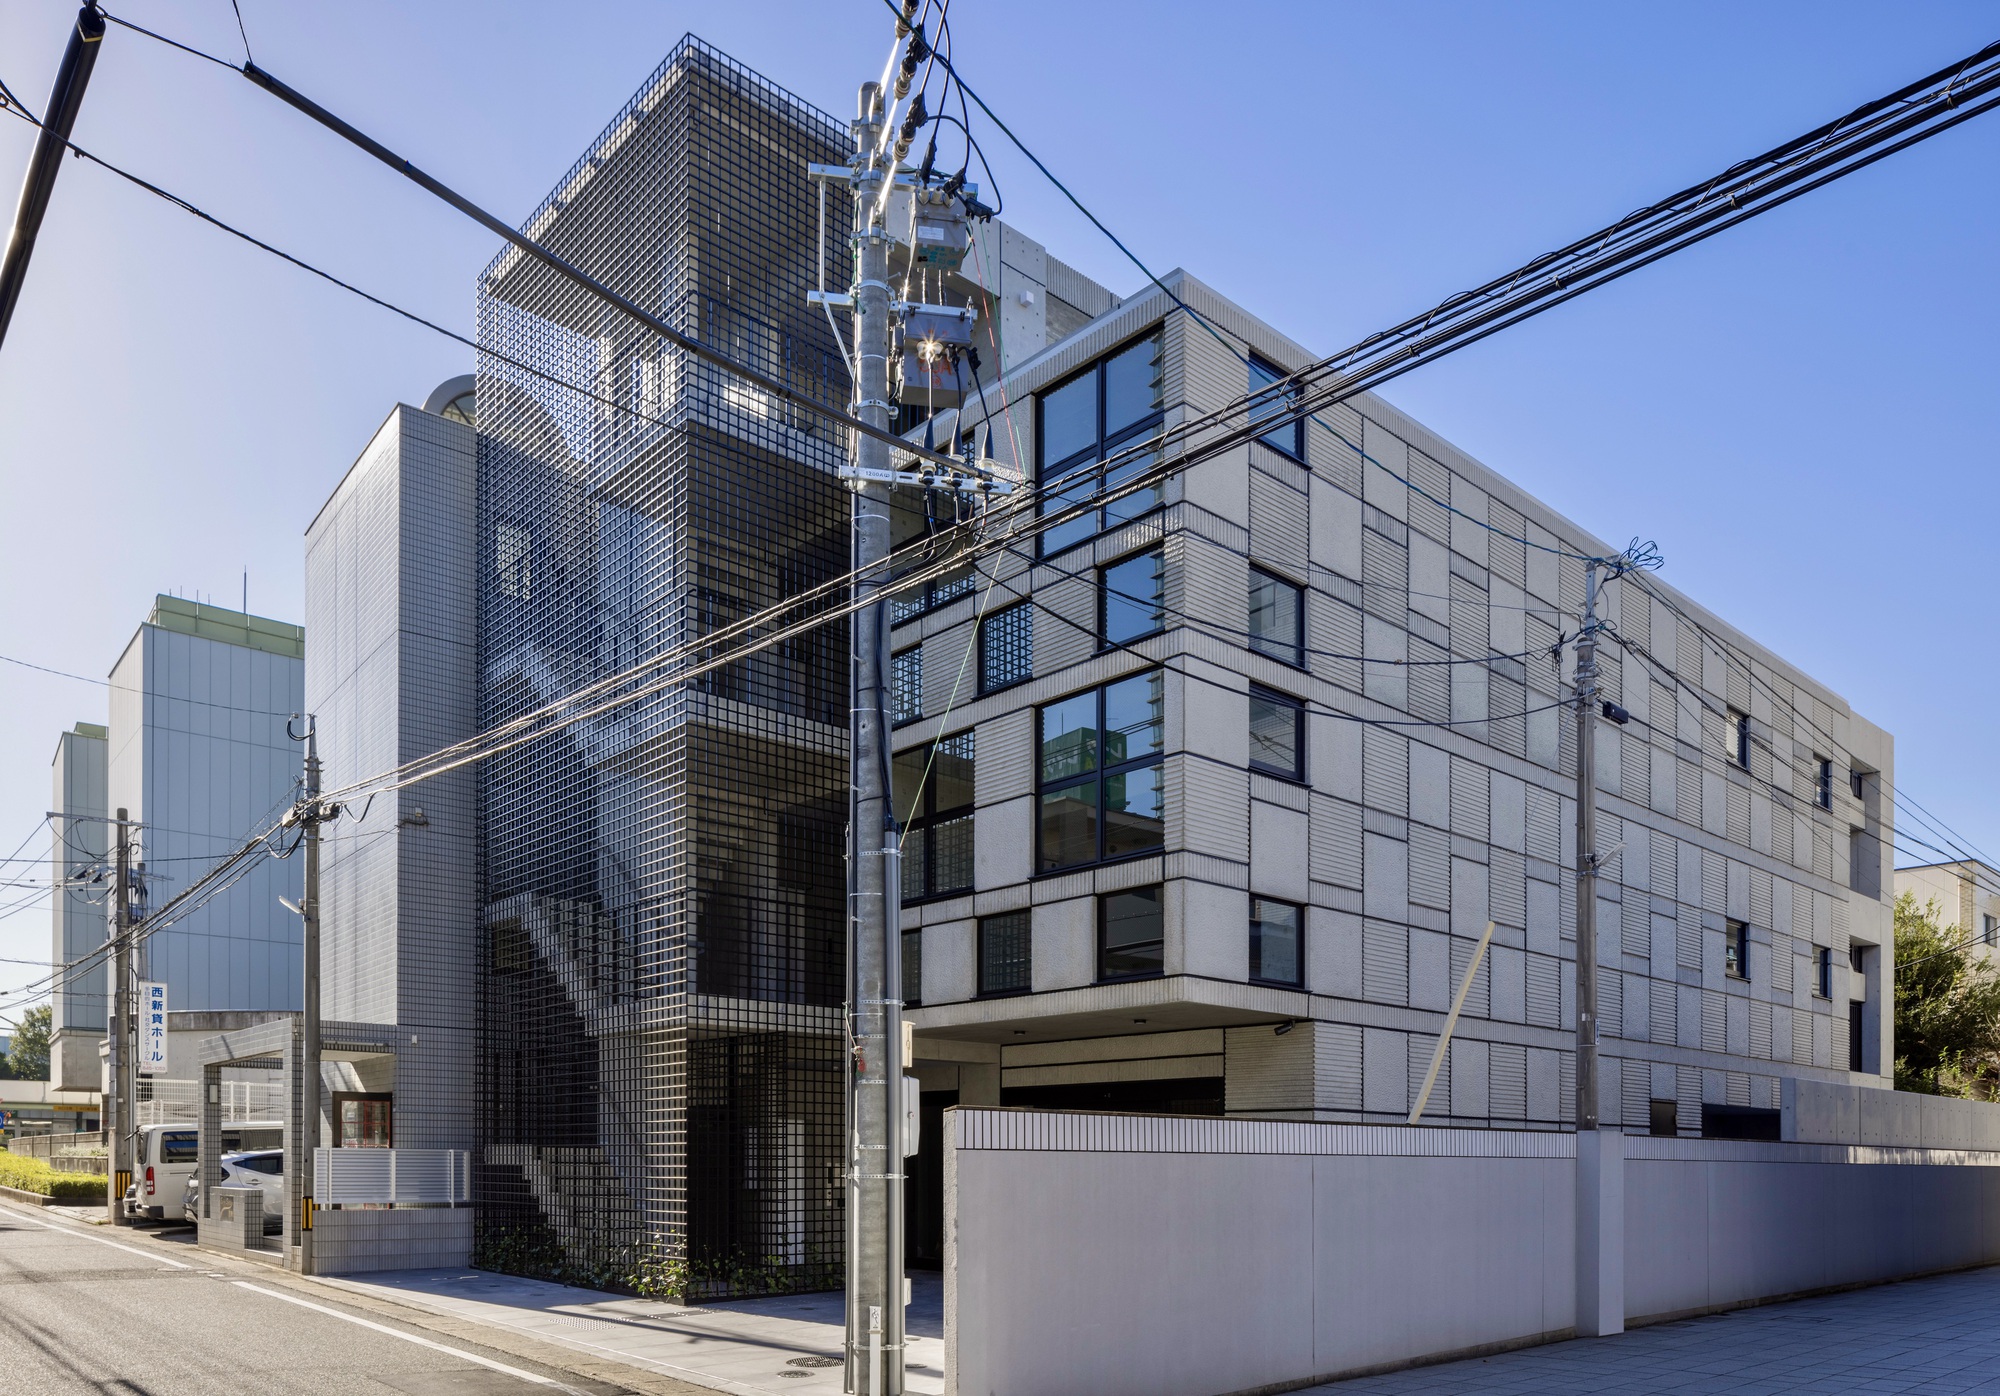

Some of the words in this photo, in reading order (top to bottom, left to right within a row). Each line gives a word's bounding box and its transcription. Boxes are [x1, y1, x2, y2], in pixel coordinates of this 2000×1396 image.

[151, 986, 163, 1061] 西新貸ホール
